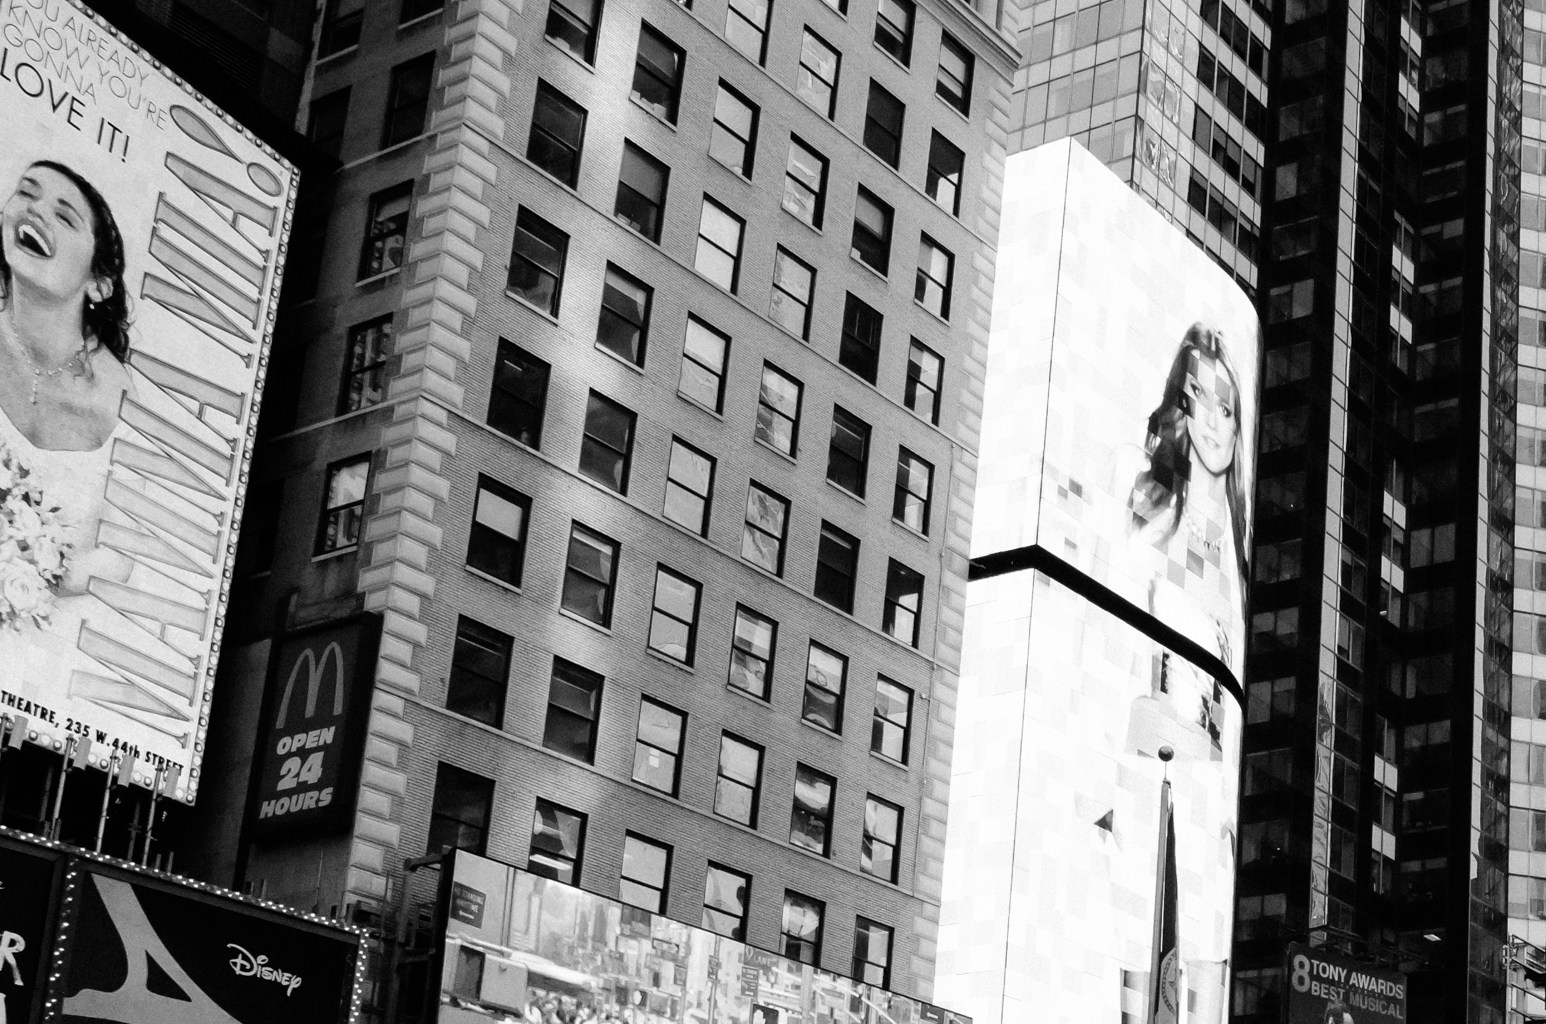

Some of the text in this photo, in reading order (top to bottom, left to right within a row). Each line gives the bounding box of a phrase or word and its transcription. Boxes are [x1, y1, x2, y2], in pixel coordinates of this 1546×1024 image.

[4, 23, 96, 105] GONNA
[63, 17, 150, 87] ALREADY
[0, 48, 130, 163] LOVE IT!
[1, 690, 60, 728] THEATRE,
[65, 718, 91, 738] 235
[276, 726, 336, 755] OPEN
[277, 752, 325, 791] 24
[259, 787, 333, 819] HOURS
[1292, 954, 1404, 999] 8 TONY AWARDS
[1311, 981, 1404, 1019] BEST MUSICAL
